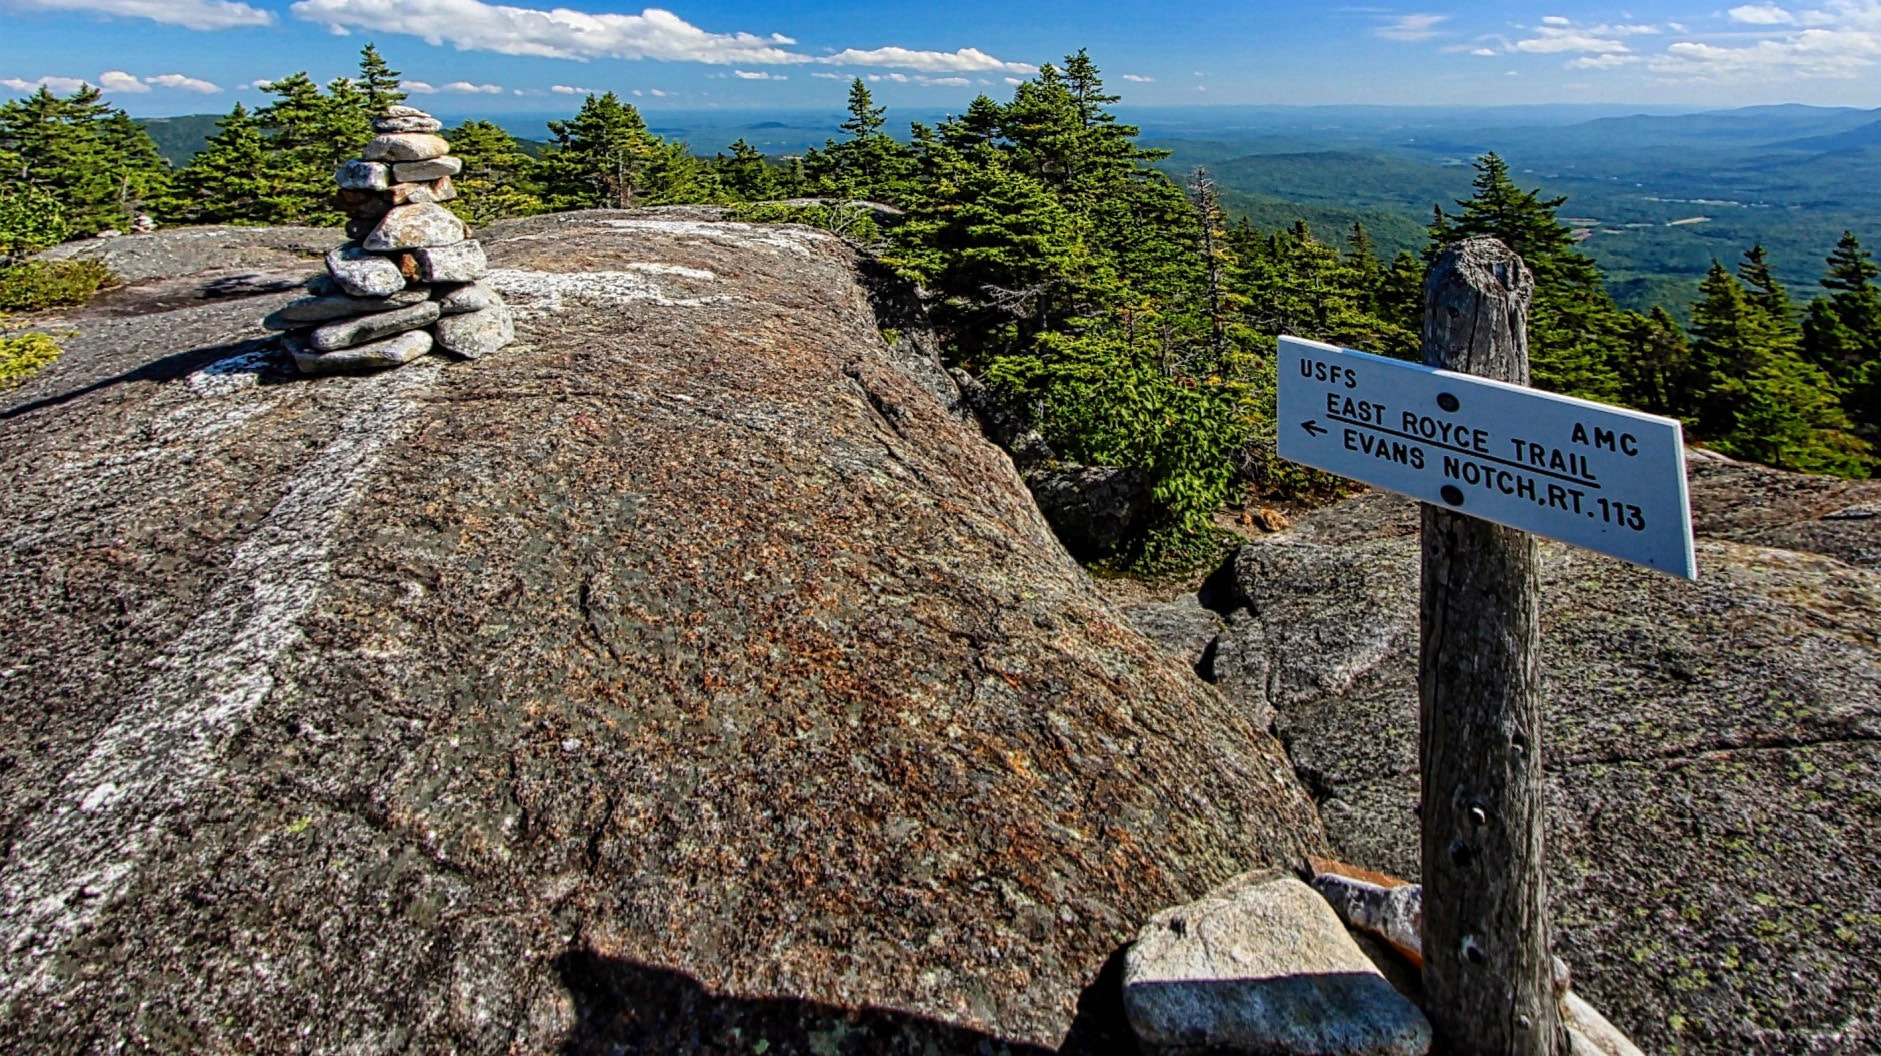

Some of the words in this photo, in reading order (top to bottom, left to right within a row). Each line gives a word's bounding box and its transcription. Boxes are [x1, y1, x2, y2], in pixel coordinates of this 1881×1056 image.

[1300, 358, 1357, 389] USFS
[1326, 392, 1387, 426] EAST
[1401, 410, 1490, 454] ROYCE
[1509, 437, 1597, 481] TRAIL
[1343, 428, 1425, 470] EVANS
[1570, 422, 1639, 457] AMC
